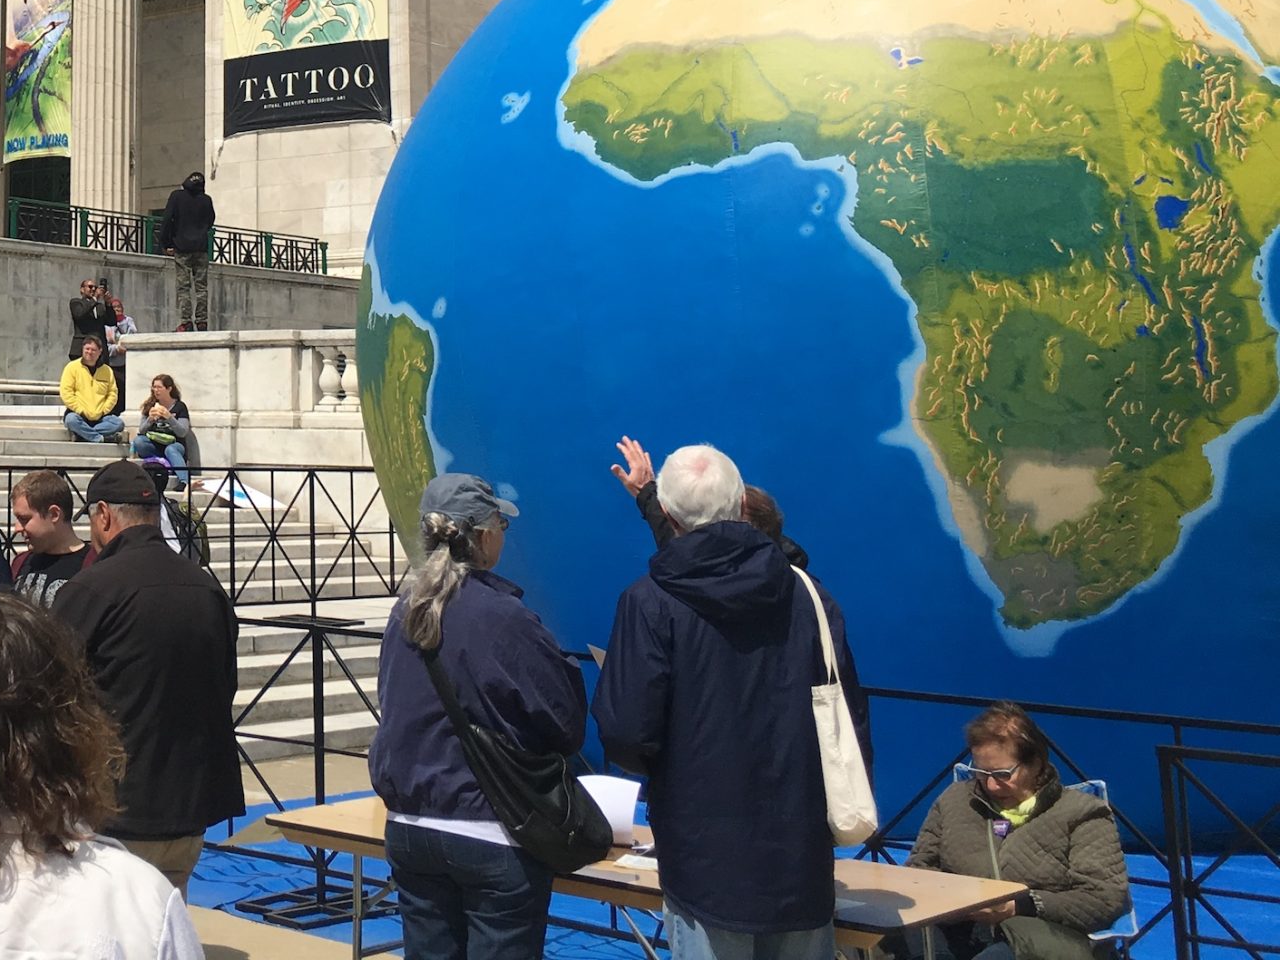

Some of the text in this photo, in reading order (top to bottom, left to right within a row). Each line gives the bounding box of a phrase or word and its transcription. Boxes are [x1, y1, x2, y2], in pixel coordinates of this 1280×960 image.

[239, 63, 375, 102] TATTOO
[6, 132, 69, 153] NOW PLAYING
